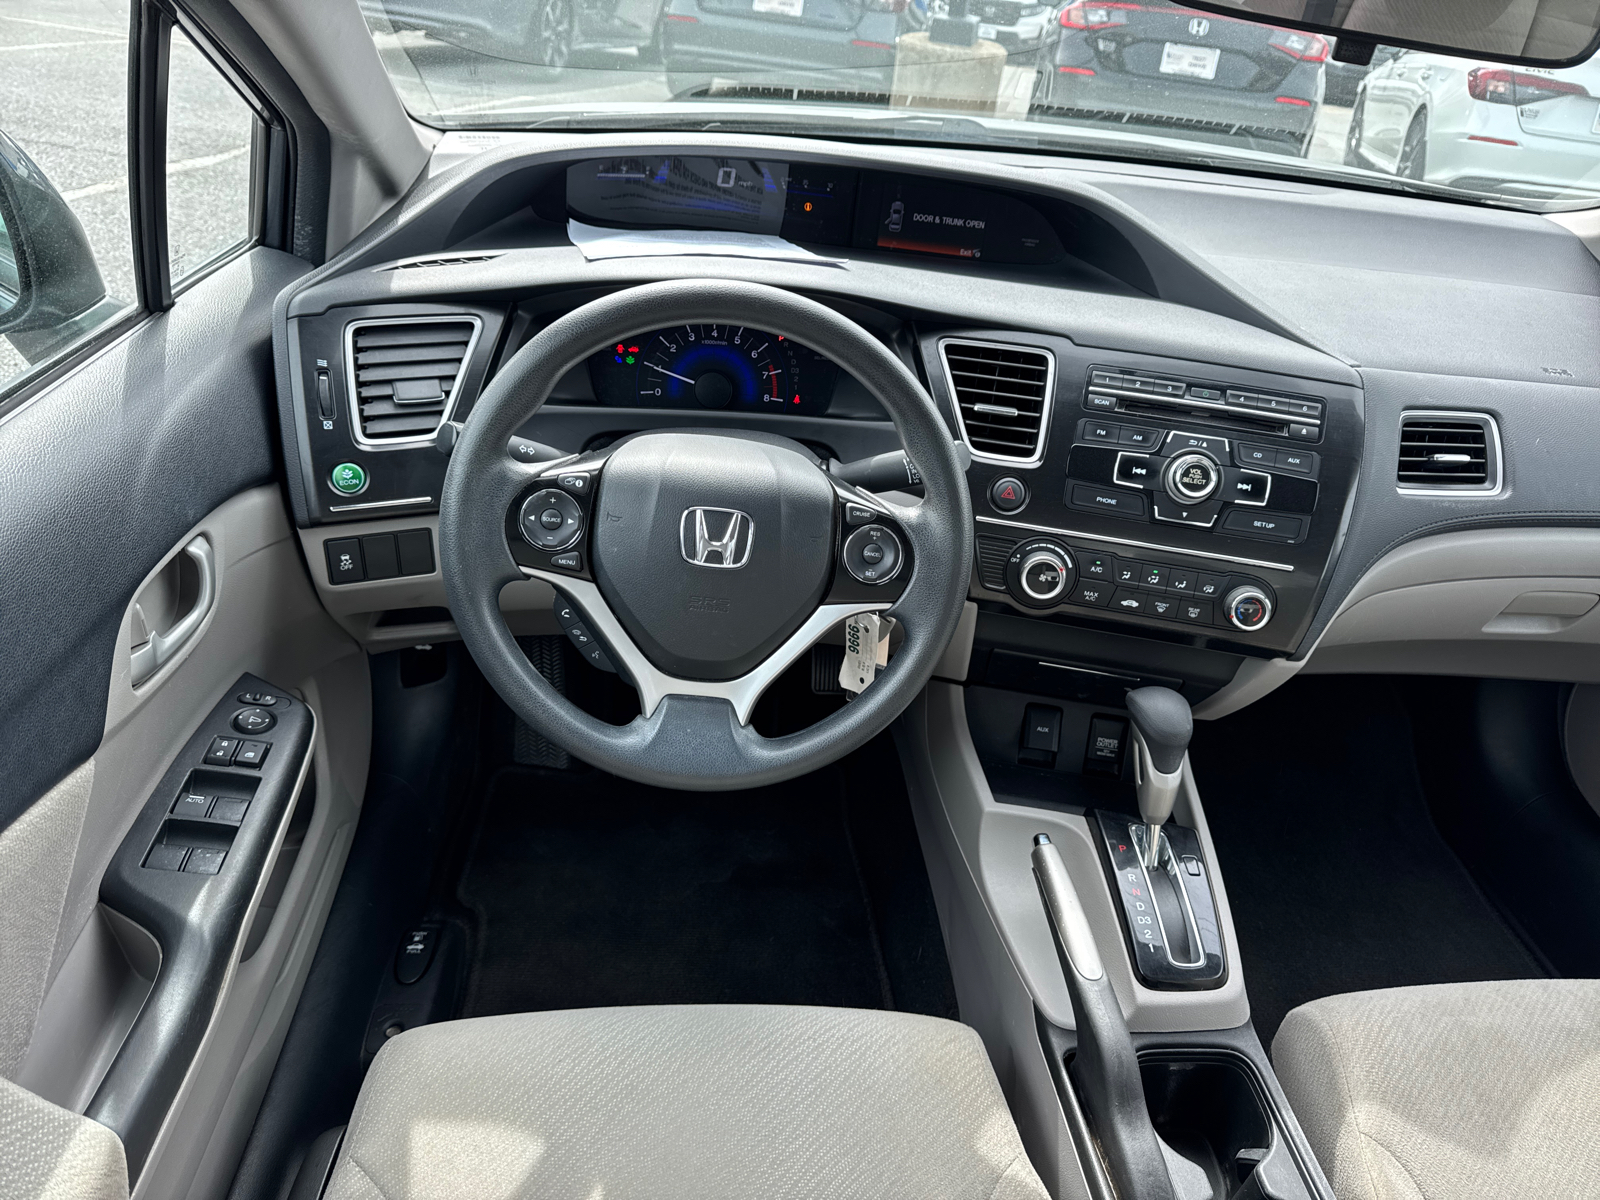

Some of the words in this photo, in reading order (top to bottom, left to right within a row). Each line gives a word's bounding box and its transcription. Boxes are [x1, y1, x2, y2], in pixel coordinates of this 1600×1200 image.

[913, 212, 934, 223] DOOR
[934, 215, 941, 224] &
[941, 216, 965, 227] TRUNK
[965, 219, 986, 229] OPEN
[960, 248, 972, 256] Exit
[688, 332, 695, 341] 3
[711, 329, 718, 337] 4
[734, 335, 741, 344] 5
[669, 344, 677, 352] 2
[751, 350, 758, 359] 6
[762, 371, 768, 380] 7
[654, 387, 662, 396] 0
[763, 393, 770, 402] 8
[1094, 398, 1110, 406] SCAN
[1287, 457, 1301, 465] AUX
[1189, 468, 1203, 476] VOL
[1182, 476, 1207, 486] SELECT
[1096, 496, 1117, 505] PHONE
[852, 510, 871, 518] CRUISE
[1253, 520, 1275, 529] SETUP
[864, 550, 881, 558] CANCEL
[340, 563, 353, 571] OFF
[1083, 590, 1099, 598] MAX
[1096, 741, 1118, 749] OUTLET
[1118, 844, 1127, 853] P
[1127, 873, 1137, 882] R
[1132, 888, 1141, 896] N
[1135, 902, 1145, 911] D
[1137, 916, 1152, 925] D3
[1144, 929, 1153, 939] 2
[1148, 943, 1155, 953] 1
